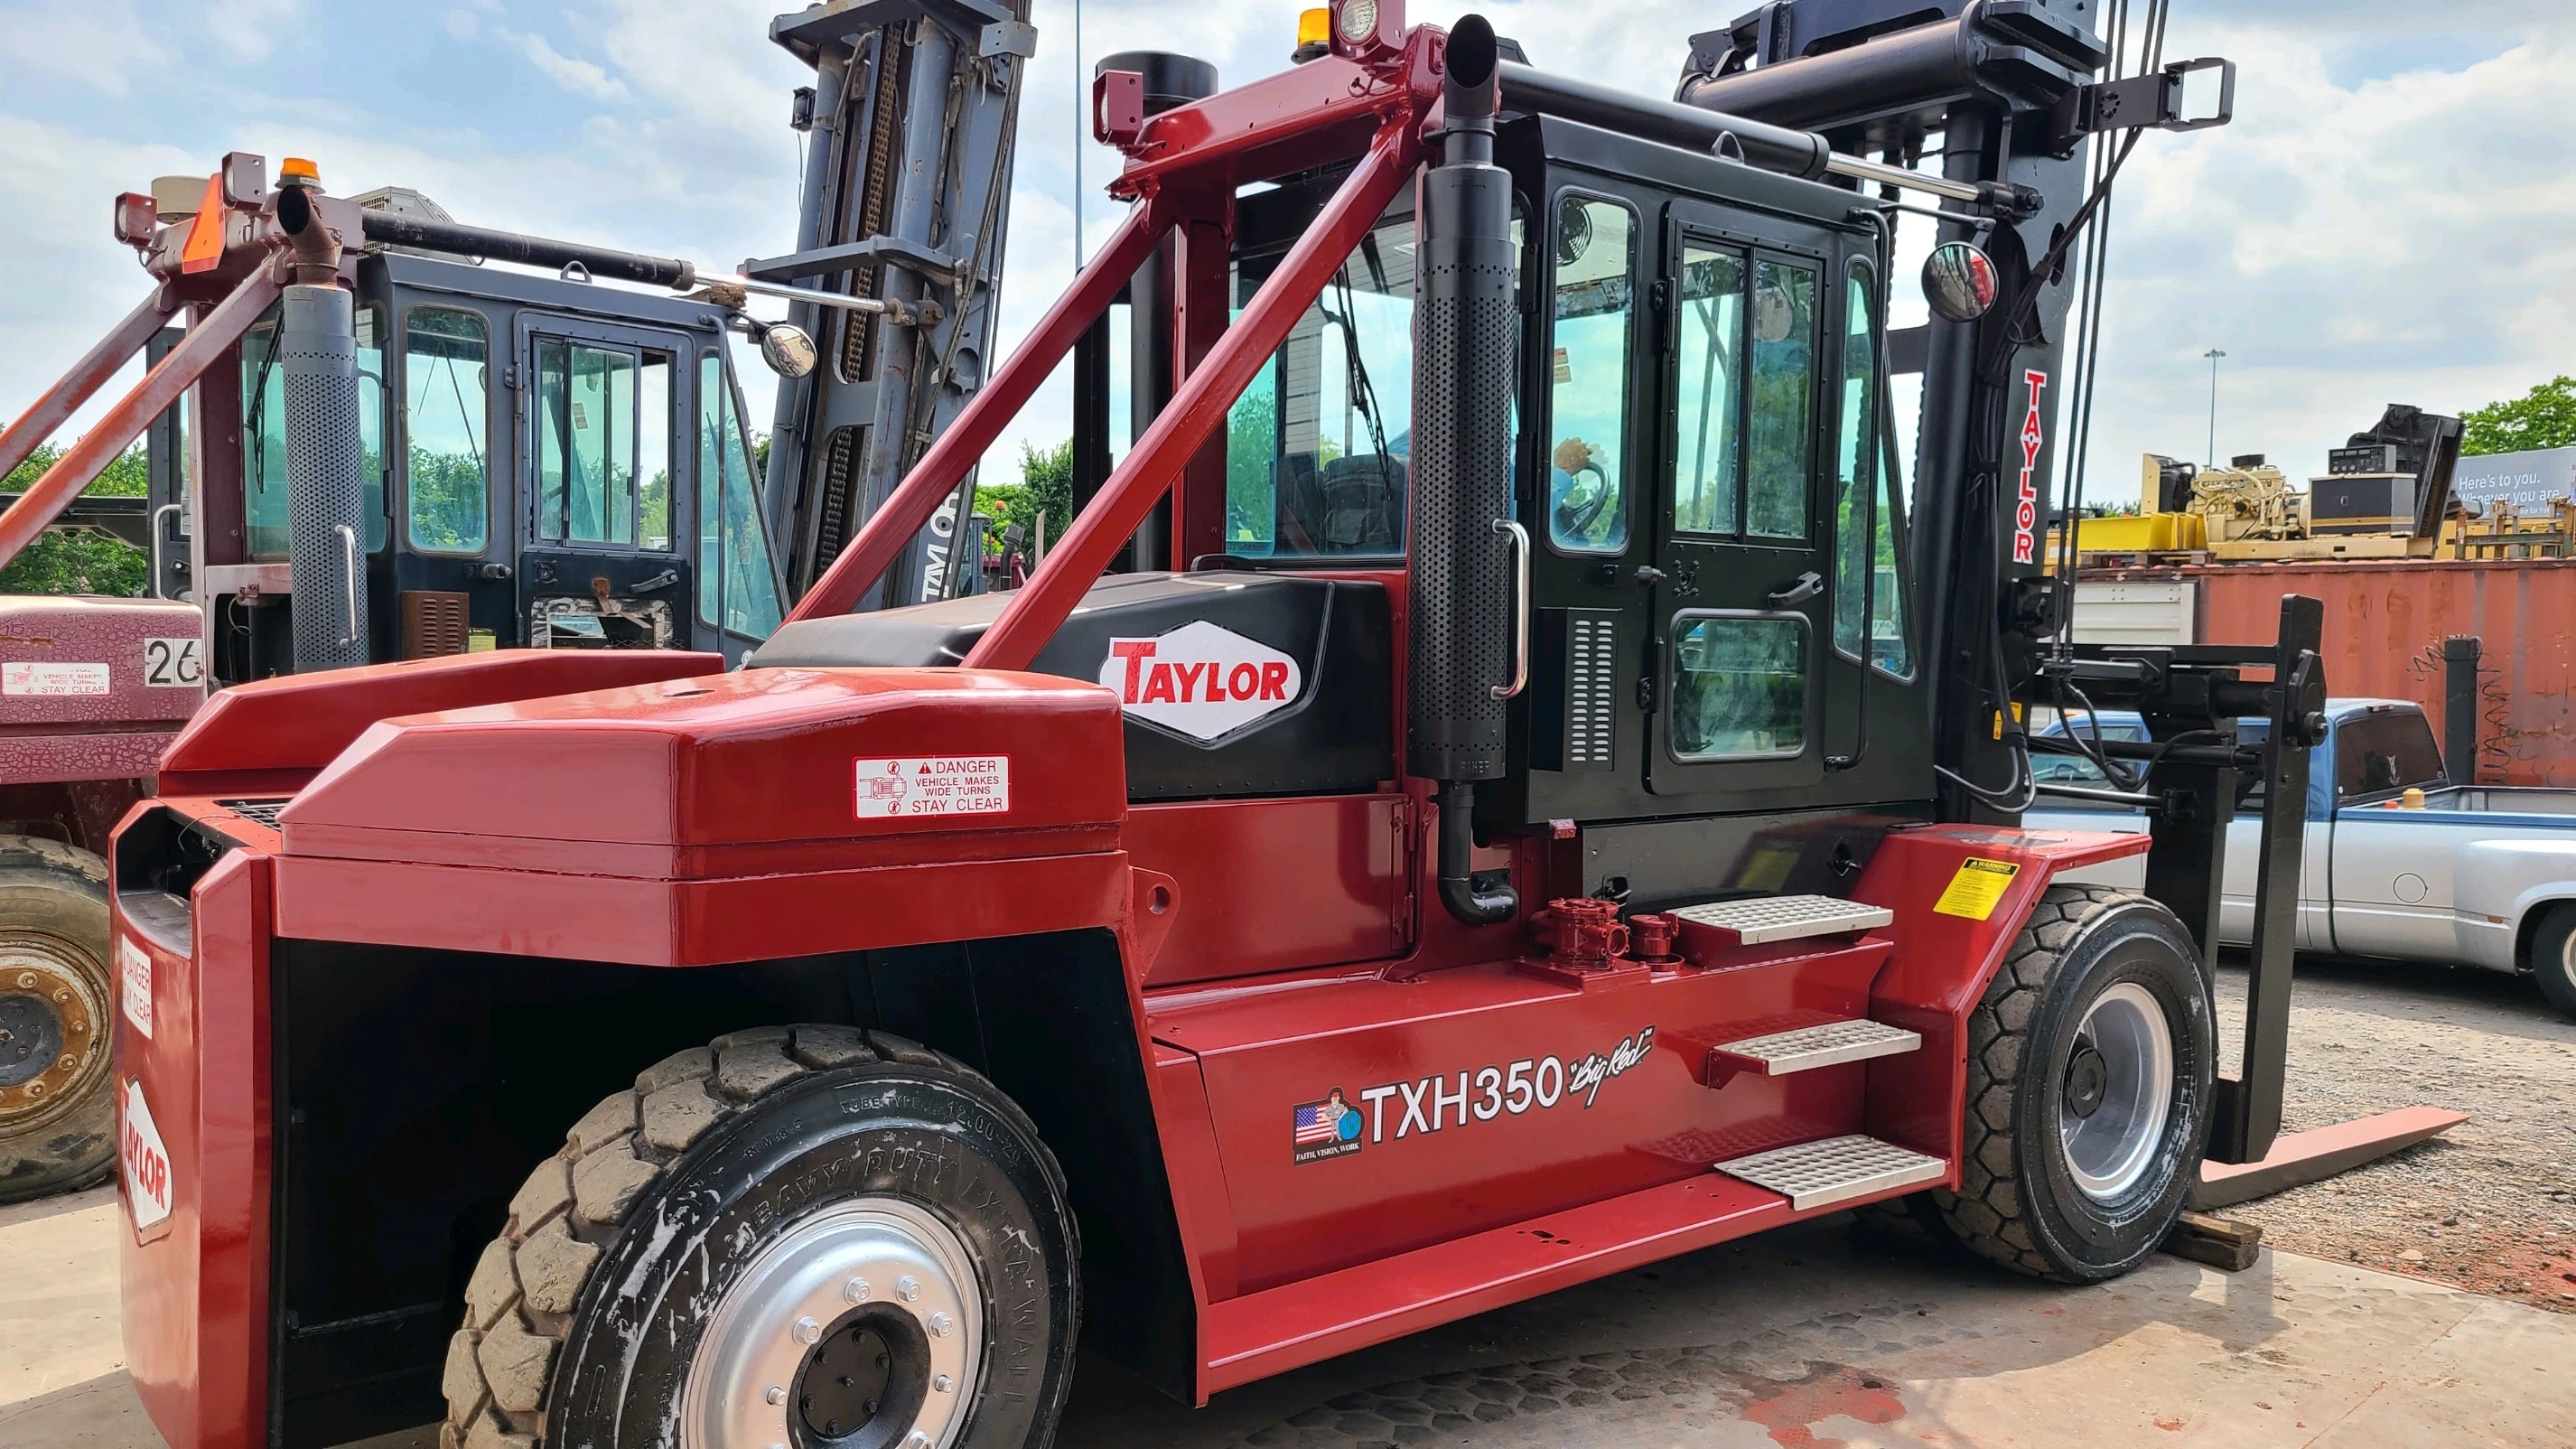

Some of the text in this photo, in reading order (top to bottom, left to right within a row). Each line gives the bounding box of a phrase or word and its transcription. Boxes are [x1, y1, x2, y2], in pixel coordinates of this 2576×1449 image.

[2014, 370, 2046, 563] TAYLOR
[2459, 473, 2540, 491] Here's to you.
[2513, 491, 2535, 505] you
[148, 640, 200, 684] 26
[1113, 642, 1289, 704] TAYLOR
[72, 686, 105, 694] CLEAR
[936, 760, 997, 774] DANGER
[915, 776, 1000, 788] VEHICLE MAKES
[925, 786, 991, 797] WIDE TURNS
[912, 798, 1003, 813] STAY CLEAR
[1977, 861, 2011, 871] WARNING
[126, 951, 150, 994] DANGER
[133, 992, 151, 1026] CLEAR
[1361, 1057, 1564, 1142] TXH350
[122, 1088, 166, 1211] TAYLOR
[1296, 1142, 1360, 1162] FAITH, VISION, WORK
